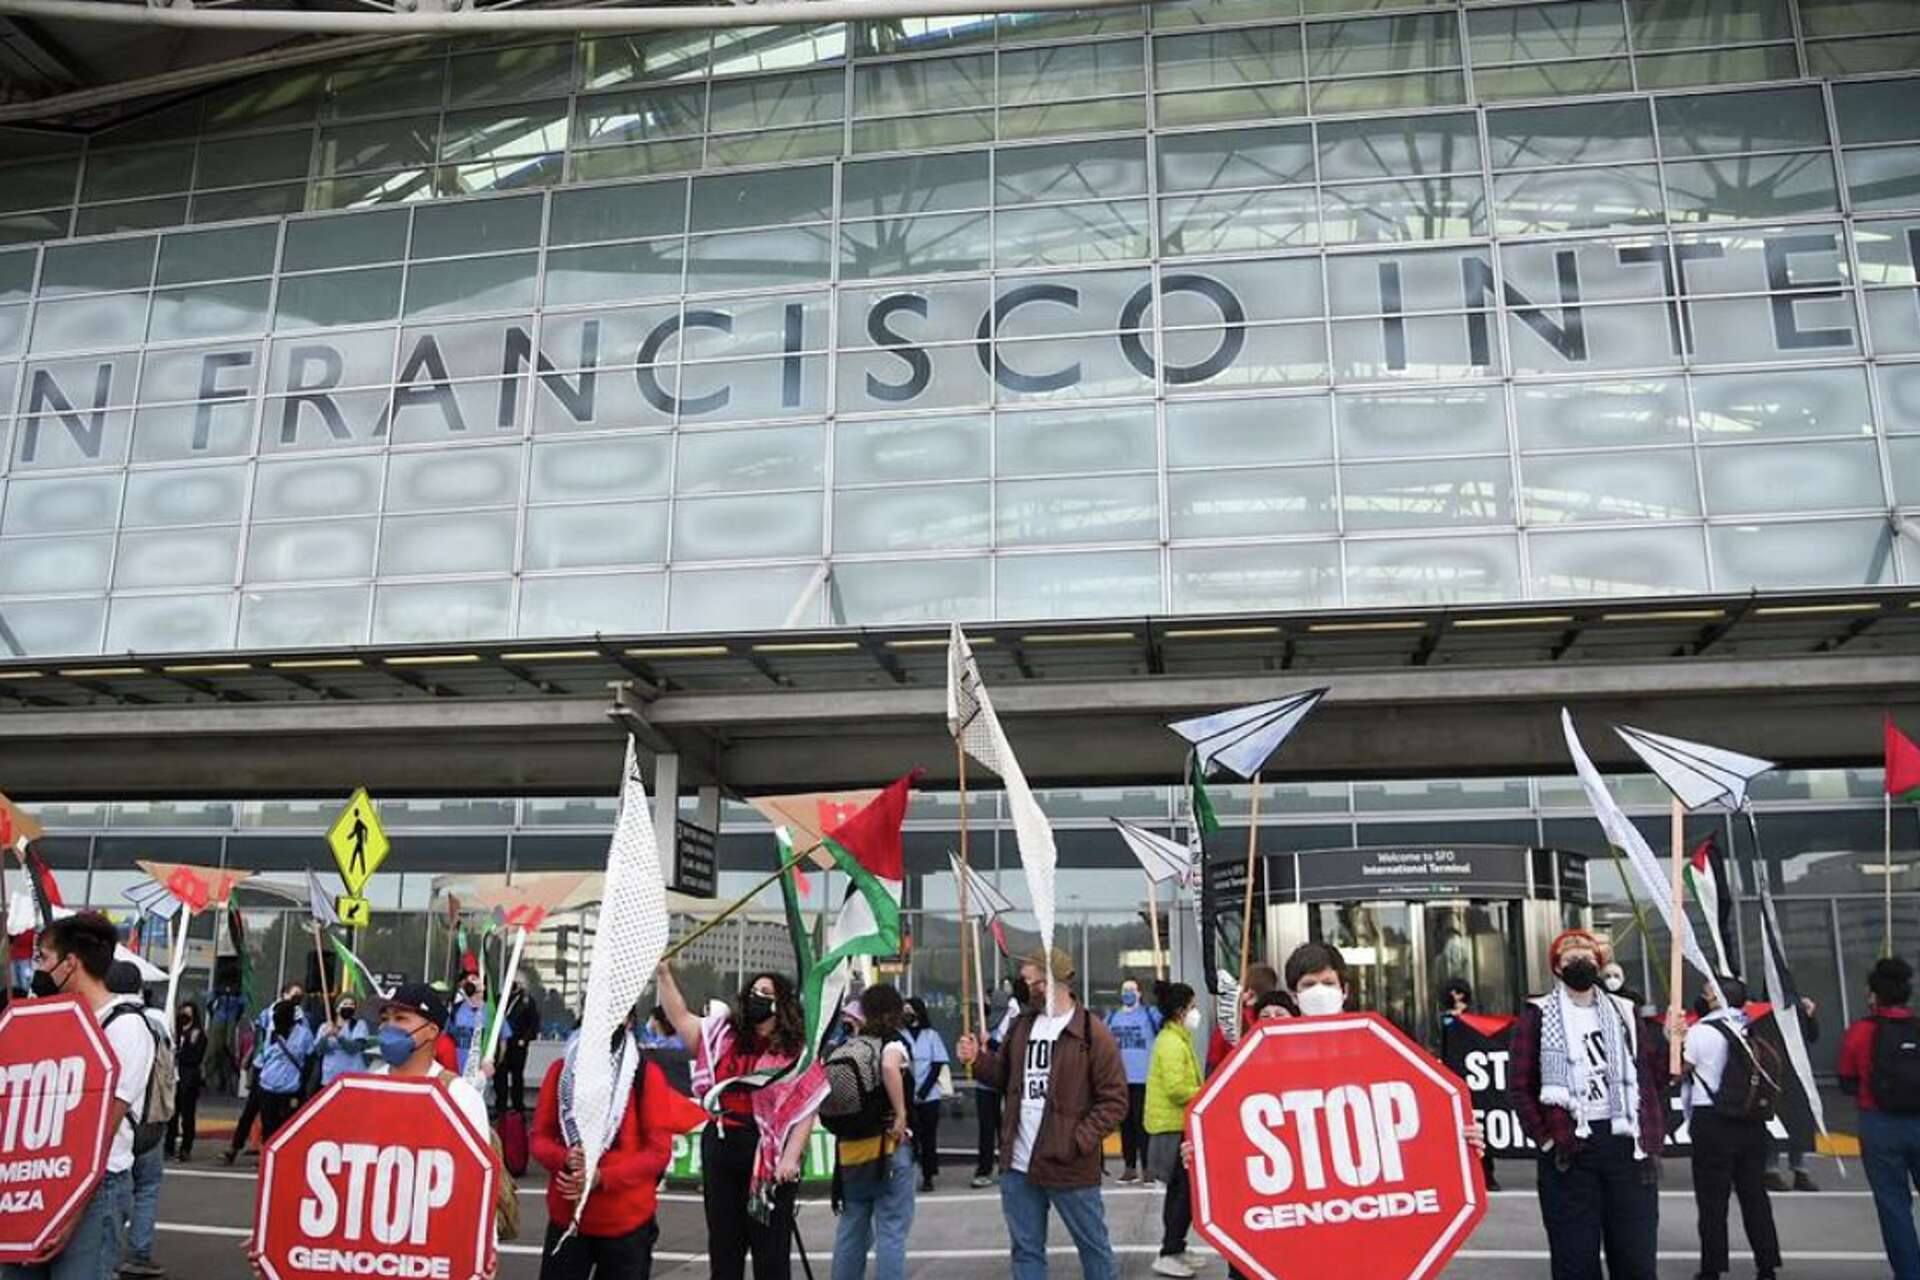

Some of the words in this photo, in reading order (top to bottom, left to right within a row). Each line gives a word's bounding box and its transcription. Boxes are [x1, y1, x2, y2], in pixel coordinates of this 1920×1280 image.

[192, 274, 1246, 451] FRANCISCO
[1378, 229, 1920, 371] INTE
[1362, 863, 1427, 875] International
[1429, 862, 1471, 874] Terminal
[1377, 851, 1420, 864] Welcome
[1423, 852, 1434, 862] to
[1435, 850, 1455, 862] SFO
[1240, 1081, 1420, 1195] STOP
[300, 1140, 454, 1245] STOP
[1243, 1189, 1440, 1231] GENOCIDE
[287, 1246, 451, 1279] GENOCIDE
